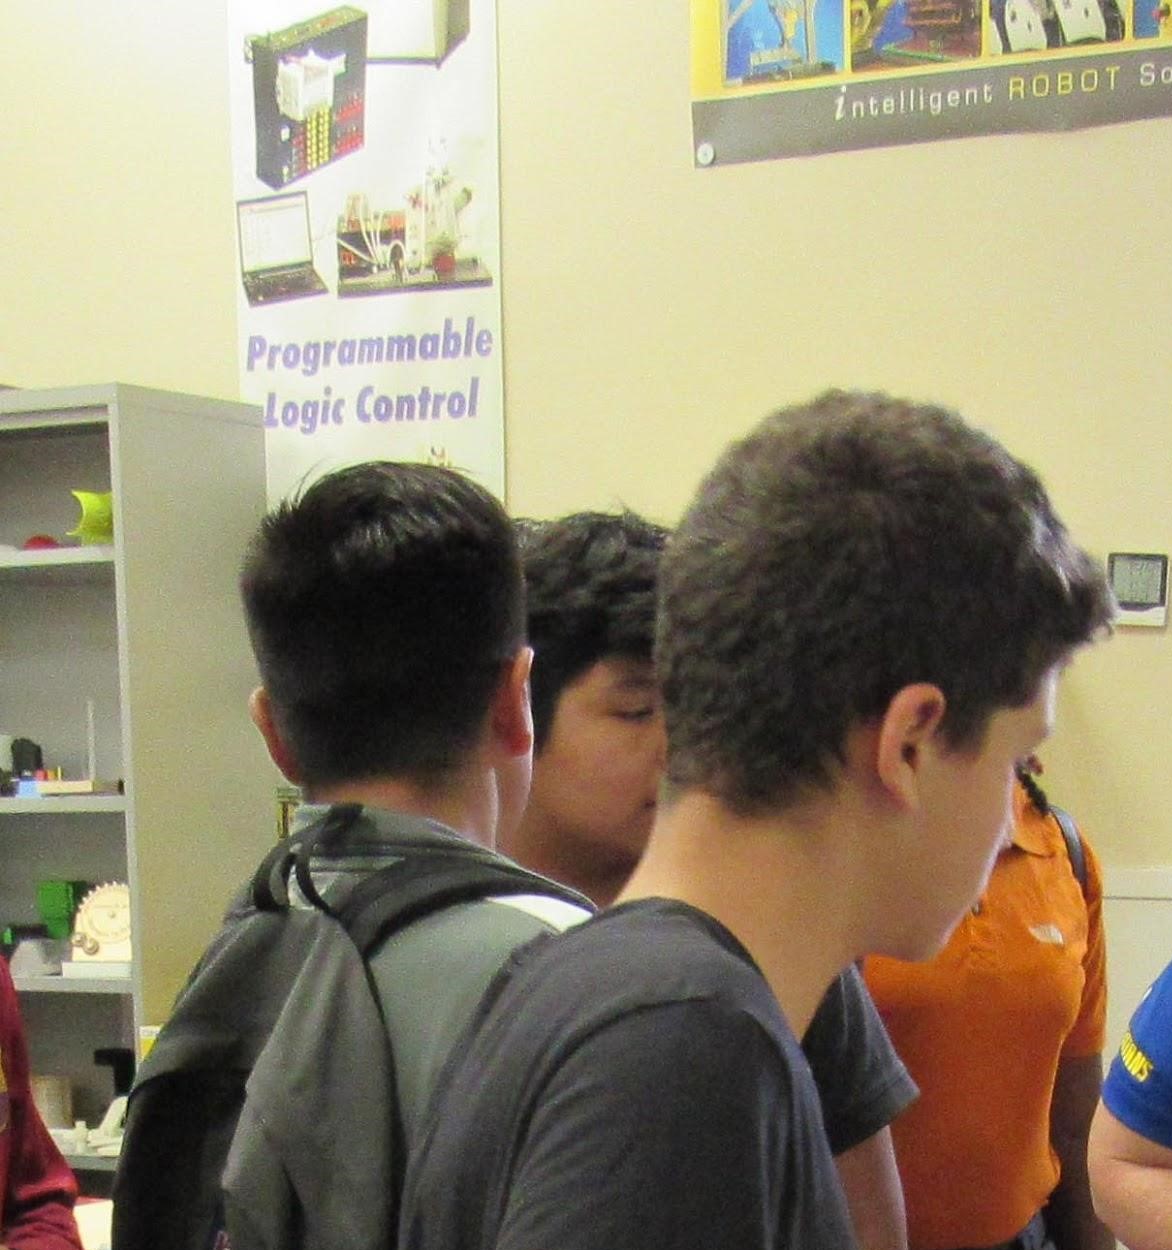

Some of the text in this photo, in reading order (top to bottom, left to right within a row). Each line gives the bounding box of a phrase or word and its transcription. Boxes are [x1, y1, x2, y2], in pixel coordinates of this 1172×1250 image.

[834, 84, 993, 121] intelligent
[1008, 66, 1121, 101] ROBOT
[246, 317, 494, 378] Programmable
[263, 377, 480, 436] Logic Control
